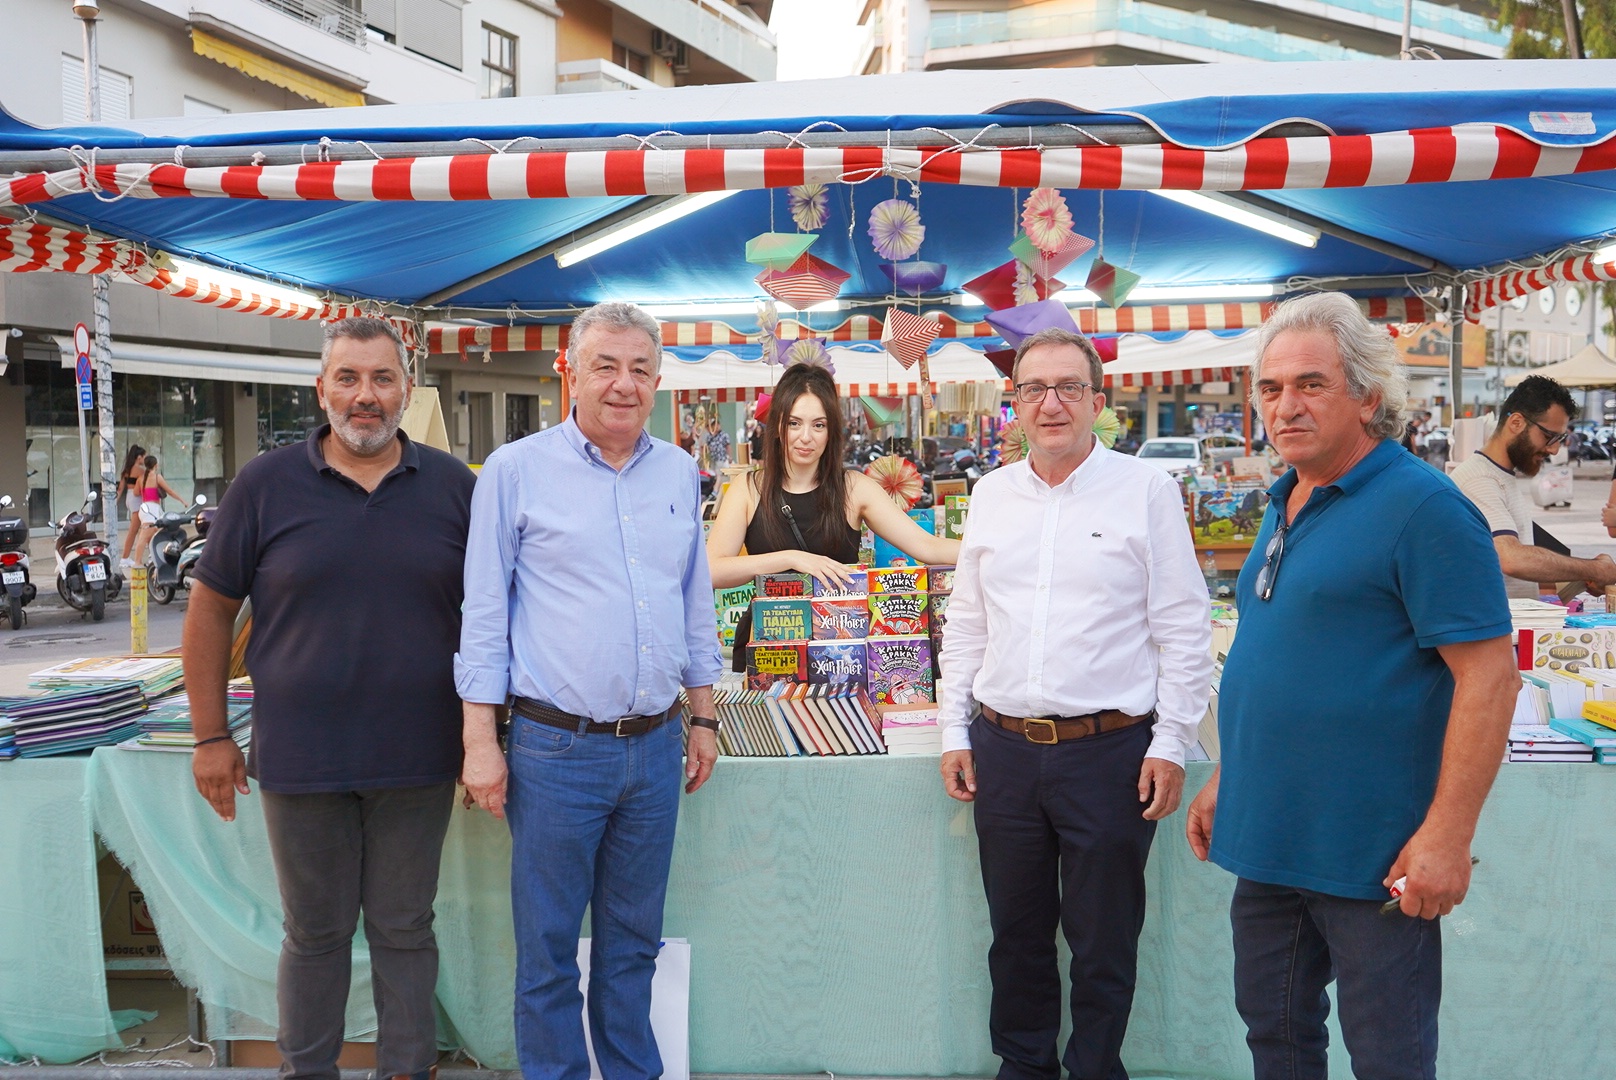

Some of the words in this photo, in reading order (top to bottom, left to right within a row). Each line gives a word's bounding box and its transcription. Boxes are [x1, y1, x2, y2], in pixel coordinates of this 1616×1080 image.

[763, 616, 804, 628] ΠΑΙΔΙΑ
[763, 627, 782, 637] ΣΤΗ
[784, 627, 805, 640] ΓΗ
[757, 657, 772, 665] ΣΤΗ
[773, 656, 788, 667] ΓΗ
